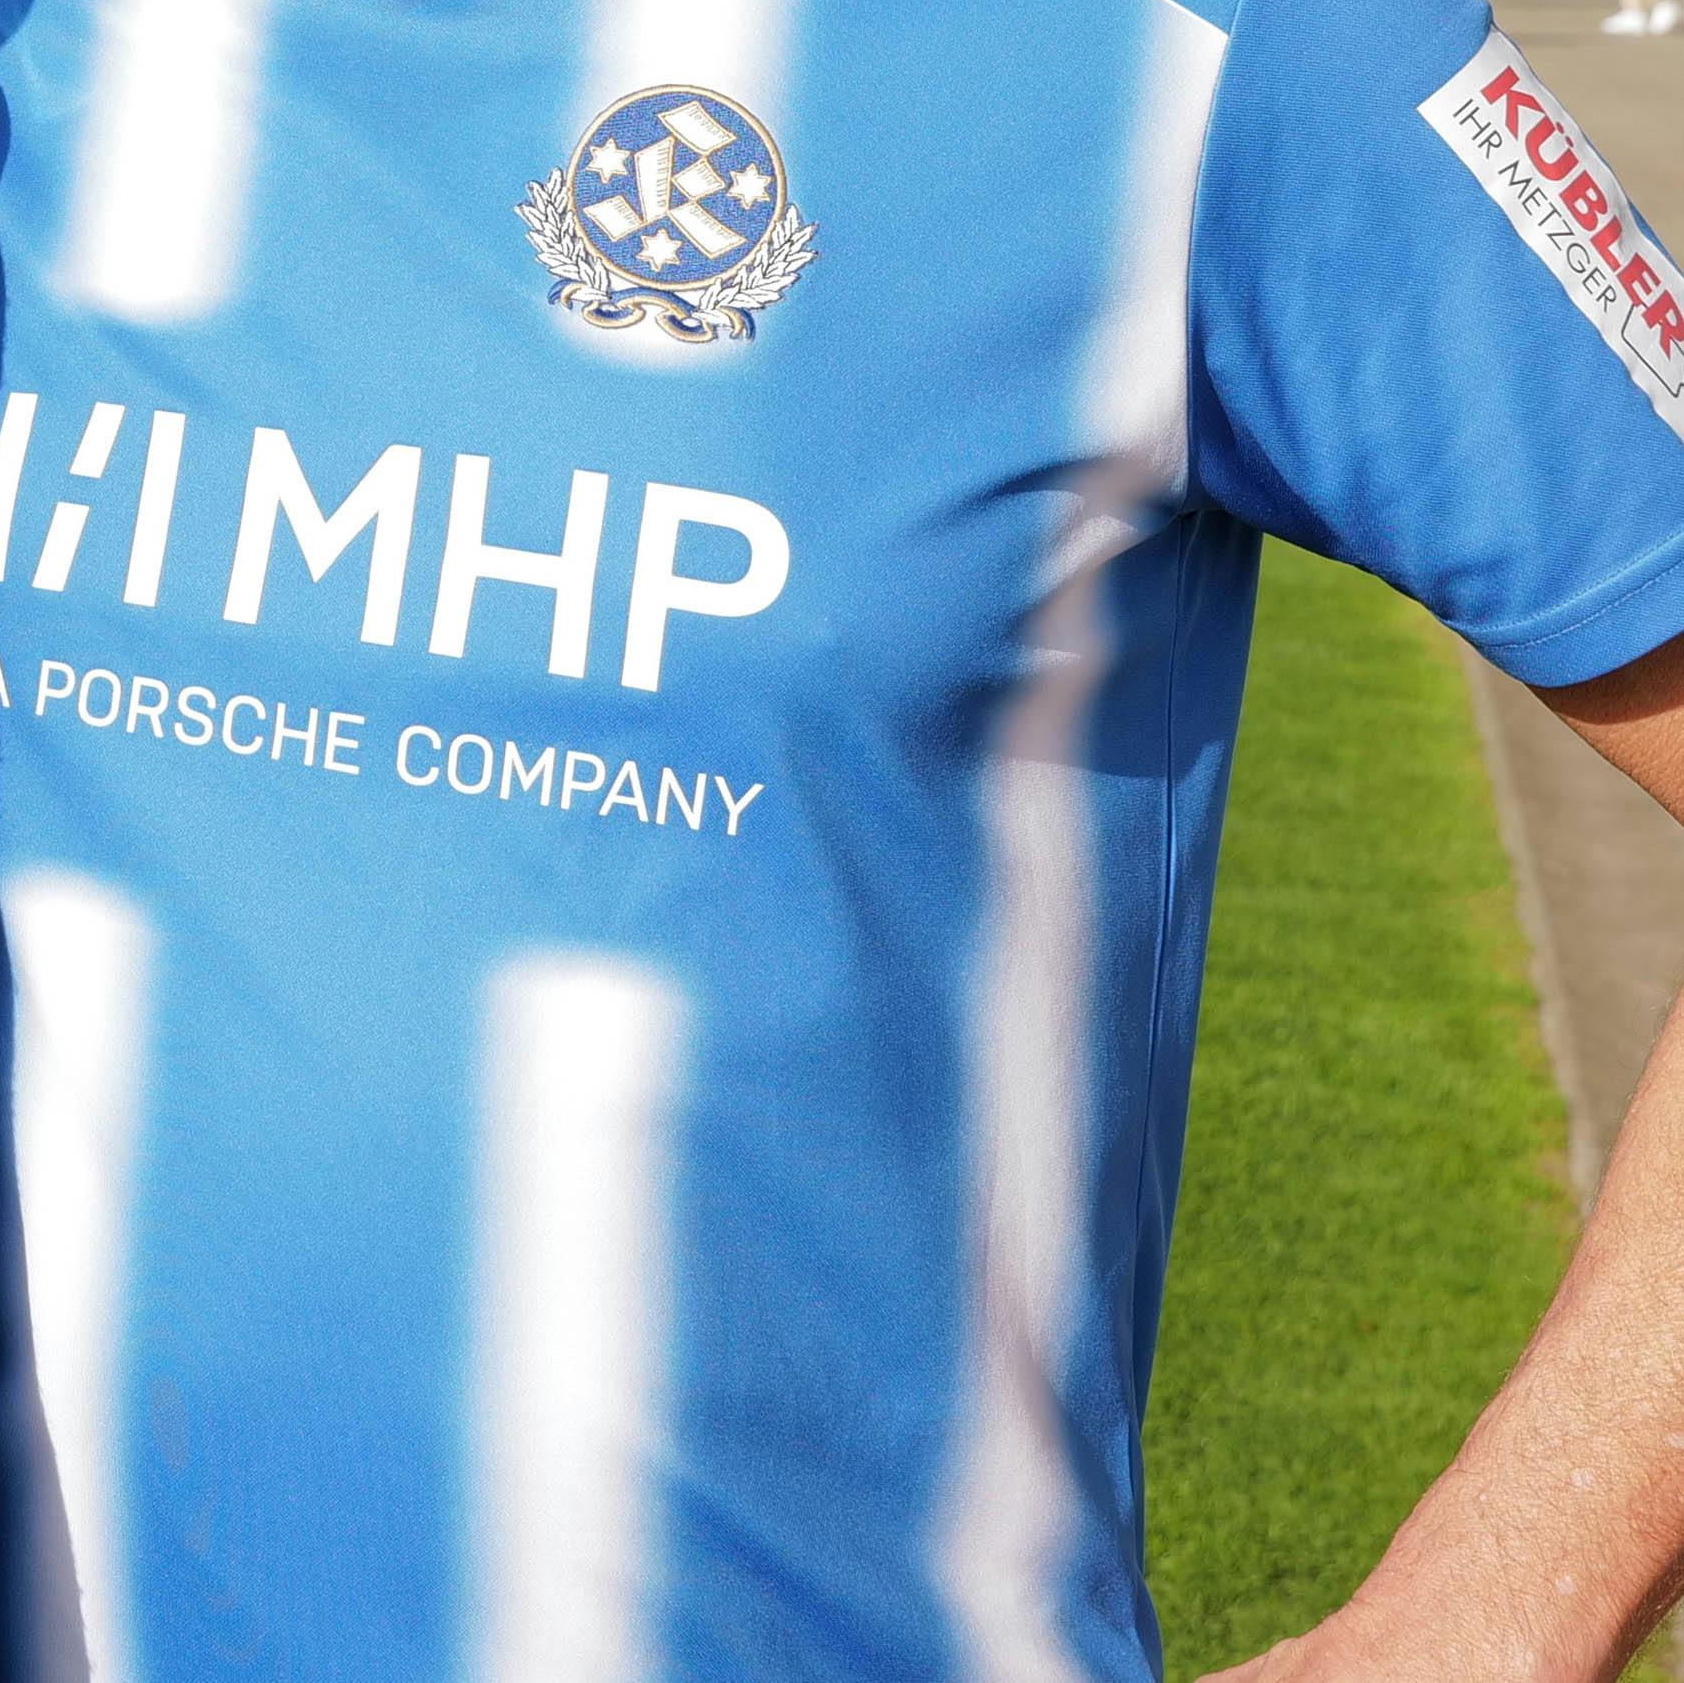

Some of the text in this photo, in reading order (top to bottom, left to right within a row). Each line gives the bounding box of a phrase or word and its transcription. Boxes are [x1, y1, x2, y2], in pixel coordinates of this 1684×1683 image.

[1453, 99, 1618, 313] IHR METZGER
[1481, 66, 1684, 359] KÜBLER
[223, 426, 791, 692] MHP
[35, 662, 366, 775] PORSCHE
[396, 725, 765, 836] COMPANY
